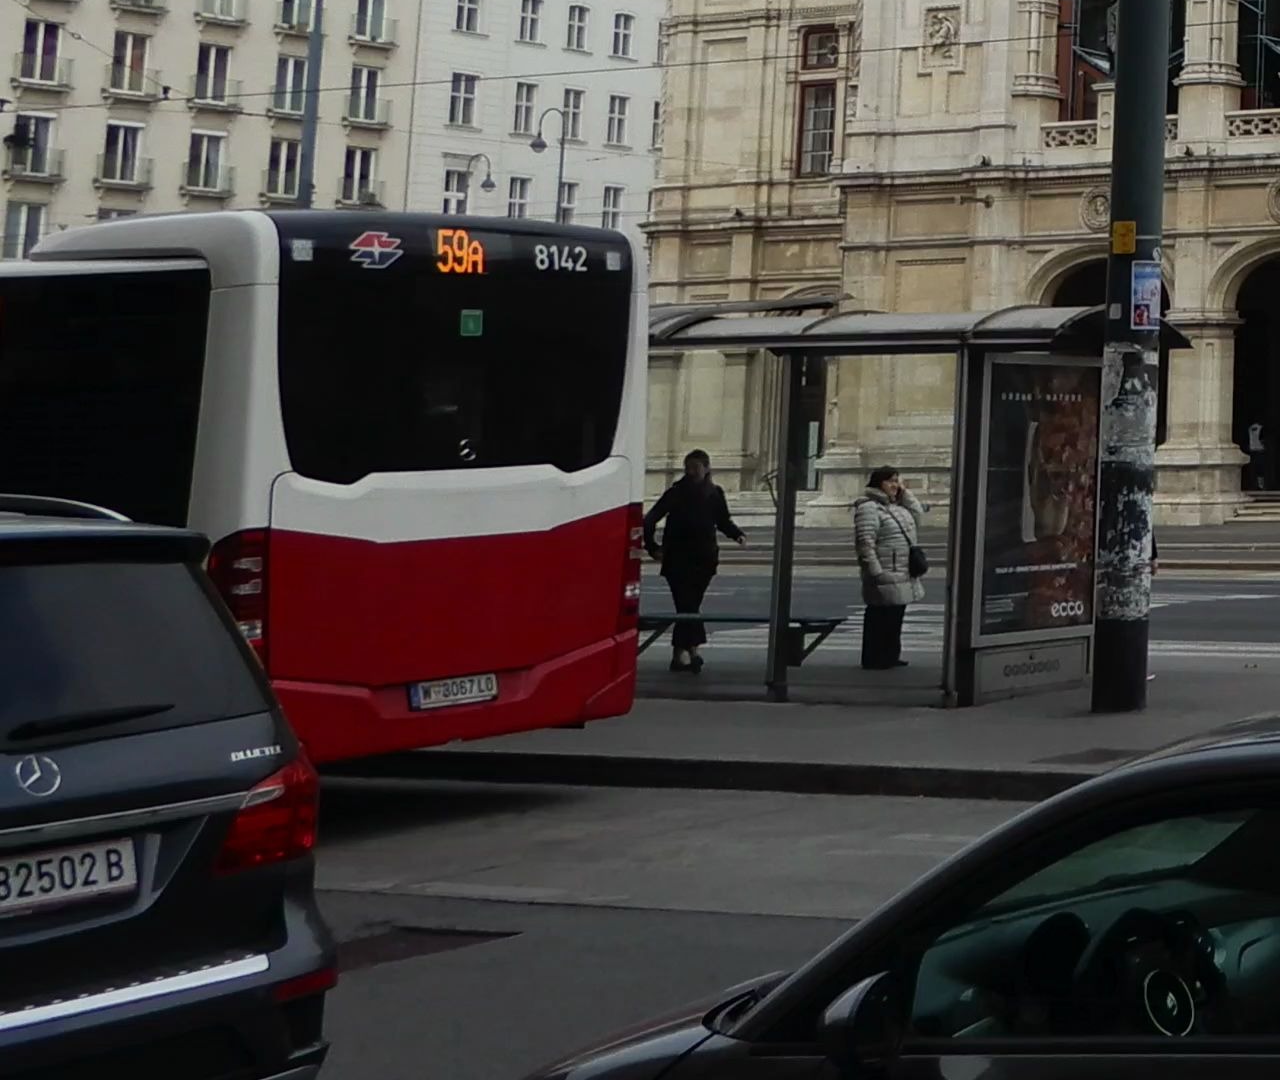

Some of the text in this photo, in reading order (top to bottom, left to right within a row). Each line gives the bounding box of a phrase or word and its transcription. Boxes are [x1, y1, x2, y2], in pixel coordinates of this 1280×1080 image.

[436, 229, 484, 273] 59A
[535, 244, 588, 272] 8142
[1051, 601, 1084, 617] ecco
[105, 847, 124, 883] B
